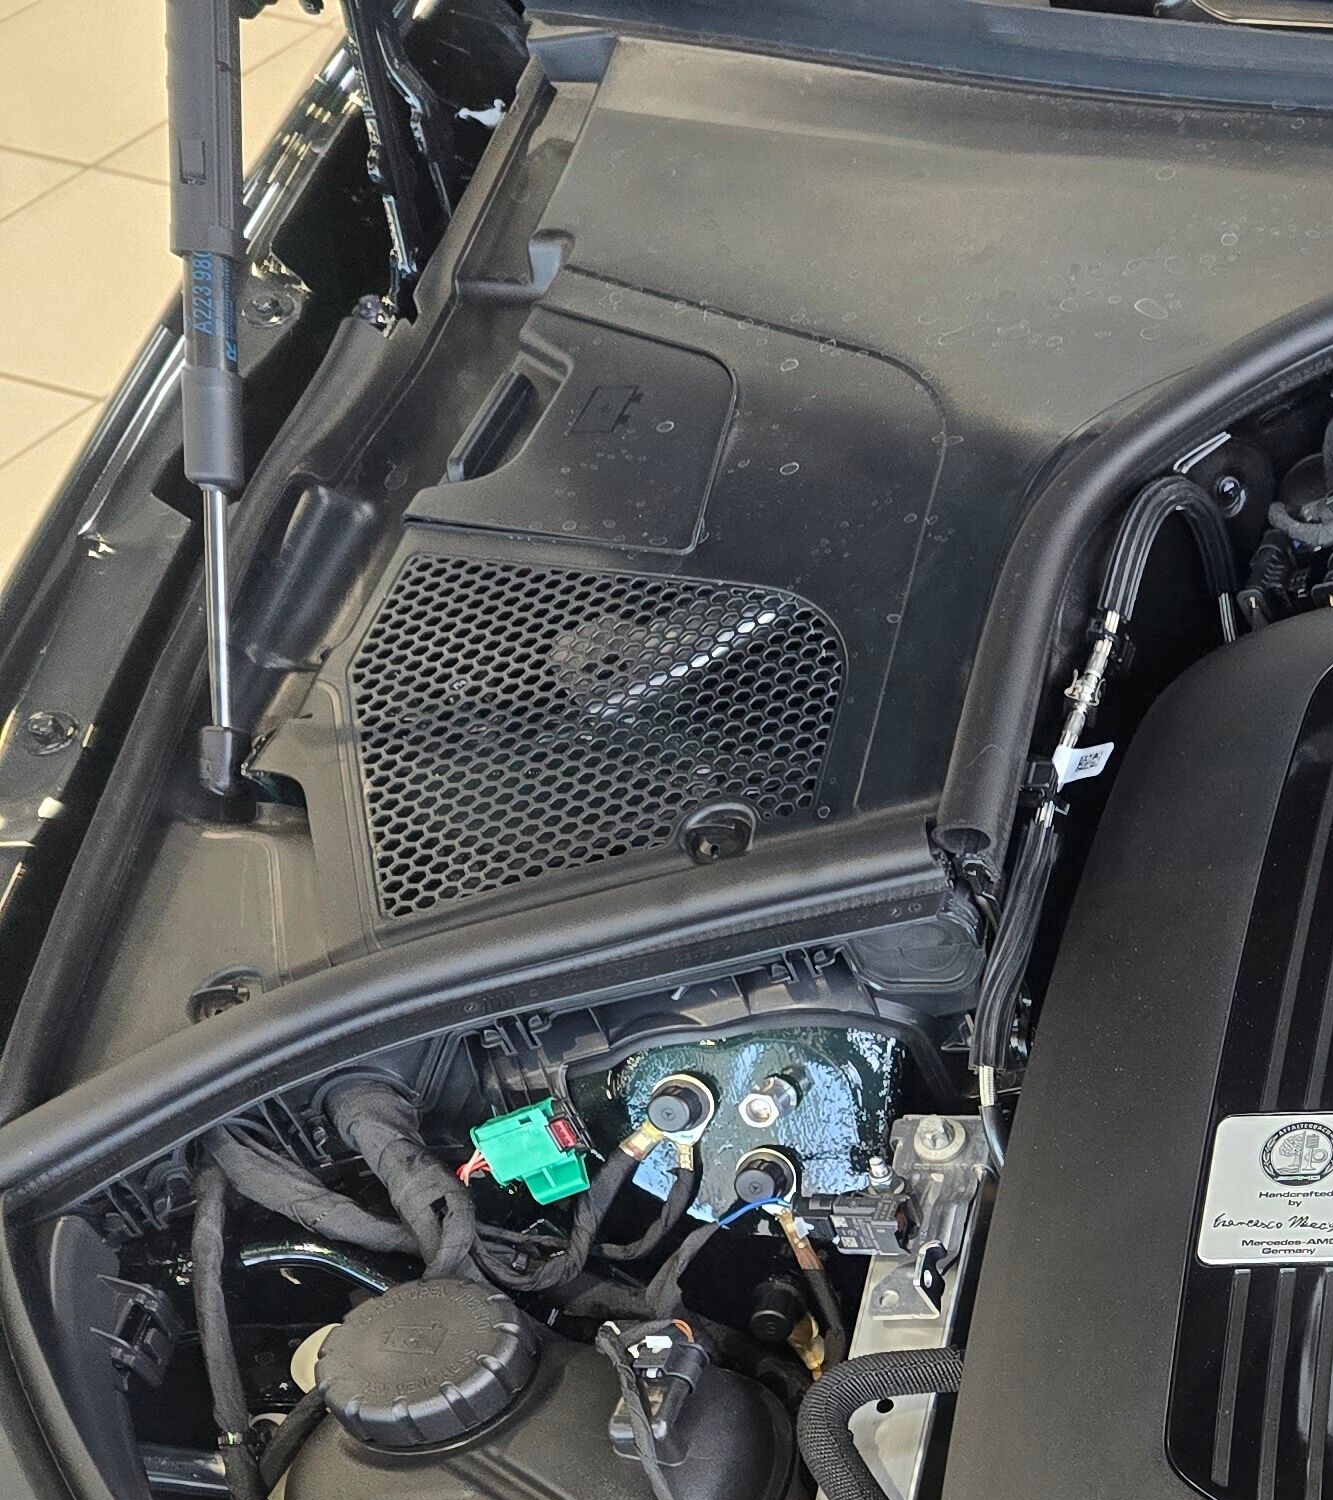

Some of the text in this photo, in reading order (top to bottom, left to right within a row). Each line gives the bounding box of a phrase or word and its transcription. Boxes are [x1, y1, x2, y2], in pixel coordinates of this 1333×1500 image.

[192, 285, 213, 335] A223
[1287, 1199, 1302, 1208] by
[1261, 1247, 1317, 1256] Germany
